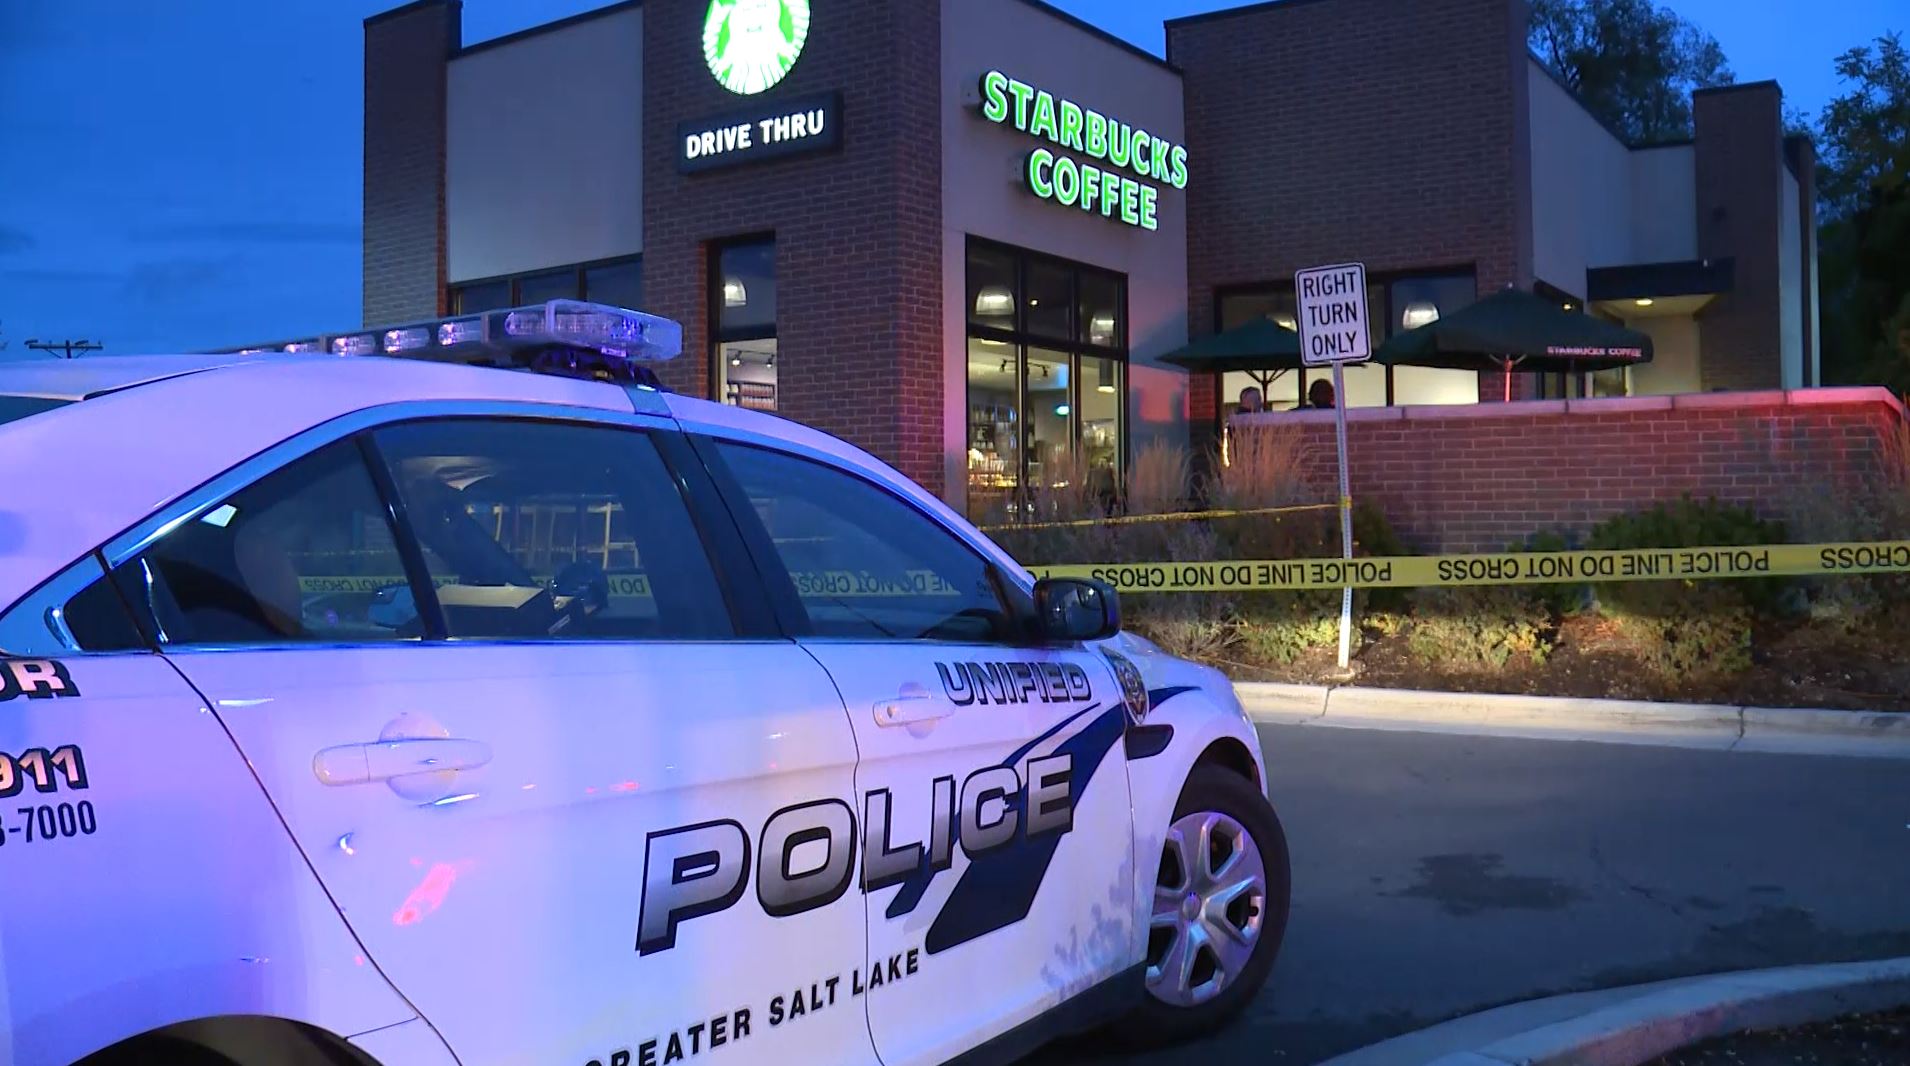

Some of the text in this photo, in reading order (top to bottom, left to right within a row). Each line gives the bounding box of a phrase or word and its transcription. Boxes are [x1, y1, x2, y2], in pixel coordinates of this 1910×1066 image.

[686, 109, 825, 160] DRIVE THRU
[983, 71, 1188, 190] STARBUCKS
[1028, 148, 1158, 231] COFFEE
[1303, 271, 1357, 299] RIGHT
[1308, 301, 1358, 328] TURN
[1311, 331, 1357, 356] ONLY
[1170, 566, 1215, 588] NOT
[1220, 565, 1251, 586] DO
[1258, 564, 1306, 585] LINE
[1312, 562, 1392, 583] POLICE
[1438, 550, 1770, 580] POLICE LINE DO NOT CROSS
[934, 661, 1092, 706] UNIFIED
[635, 753, 1075, 957] POLICE
[769, 976, 840, 1026] SALT
[851, 947, 920, 996] LAKE
